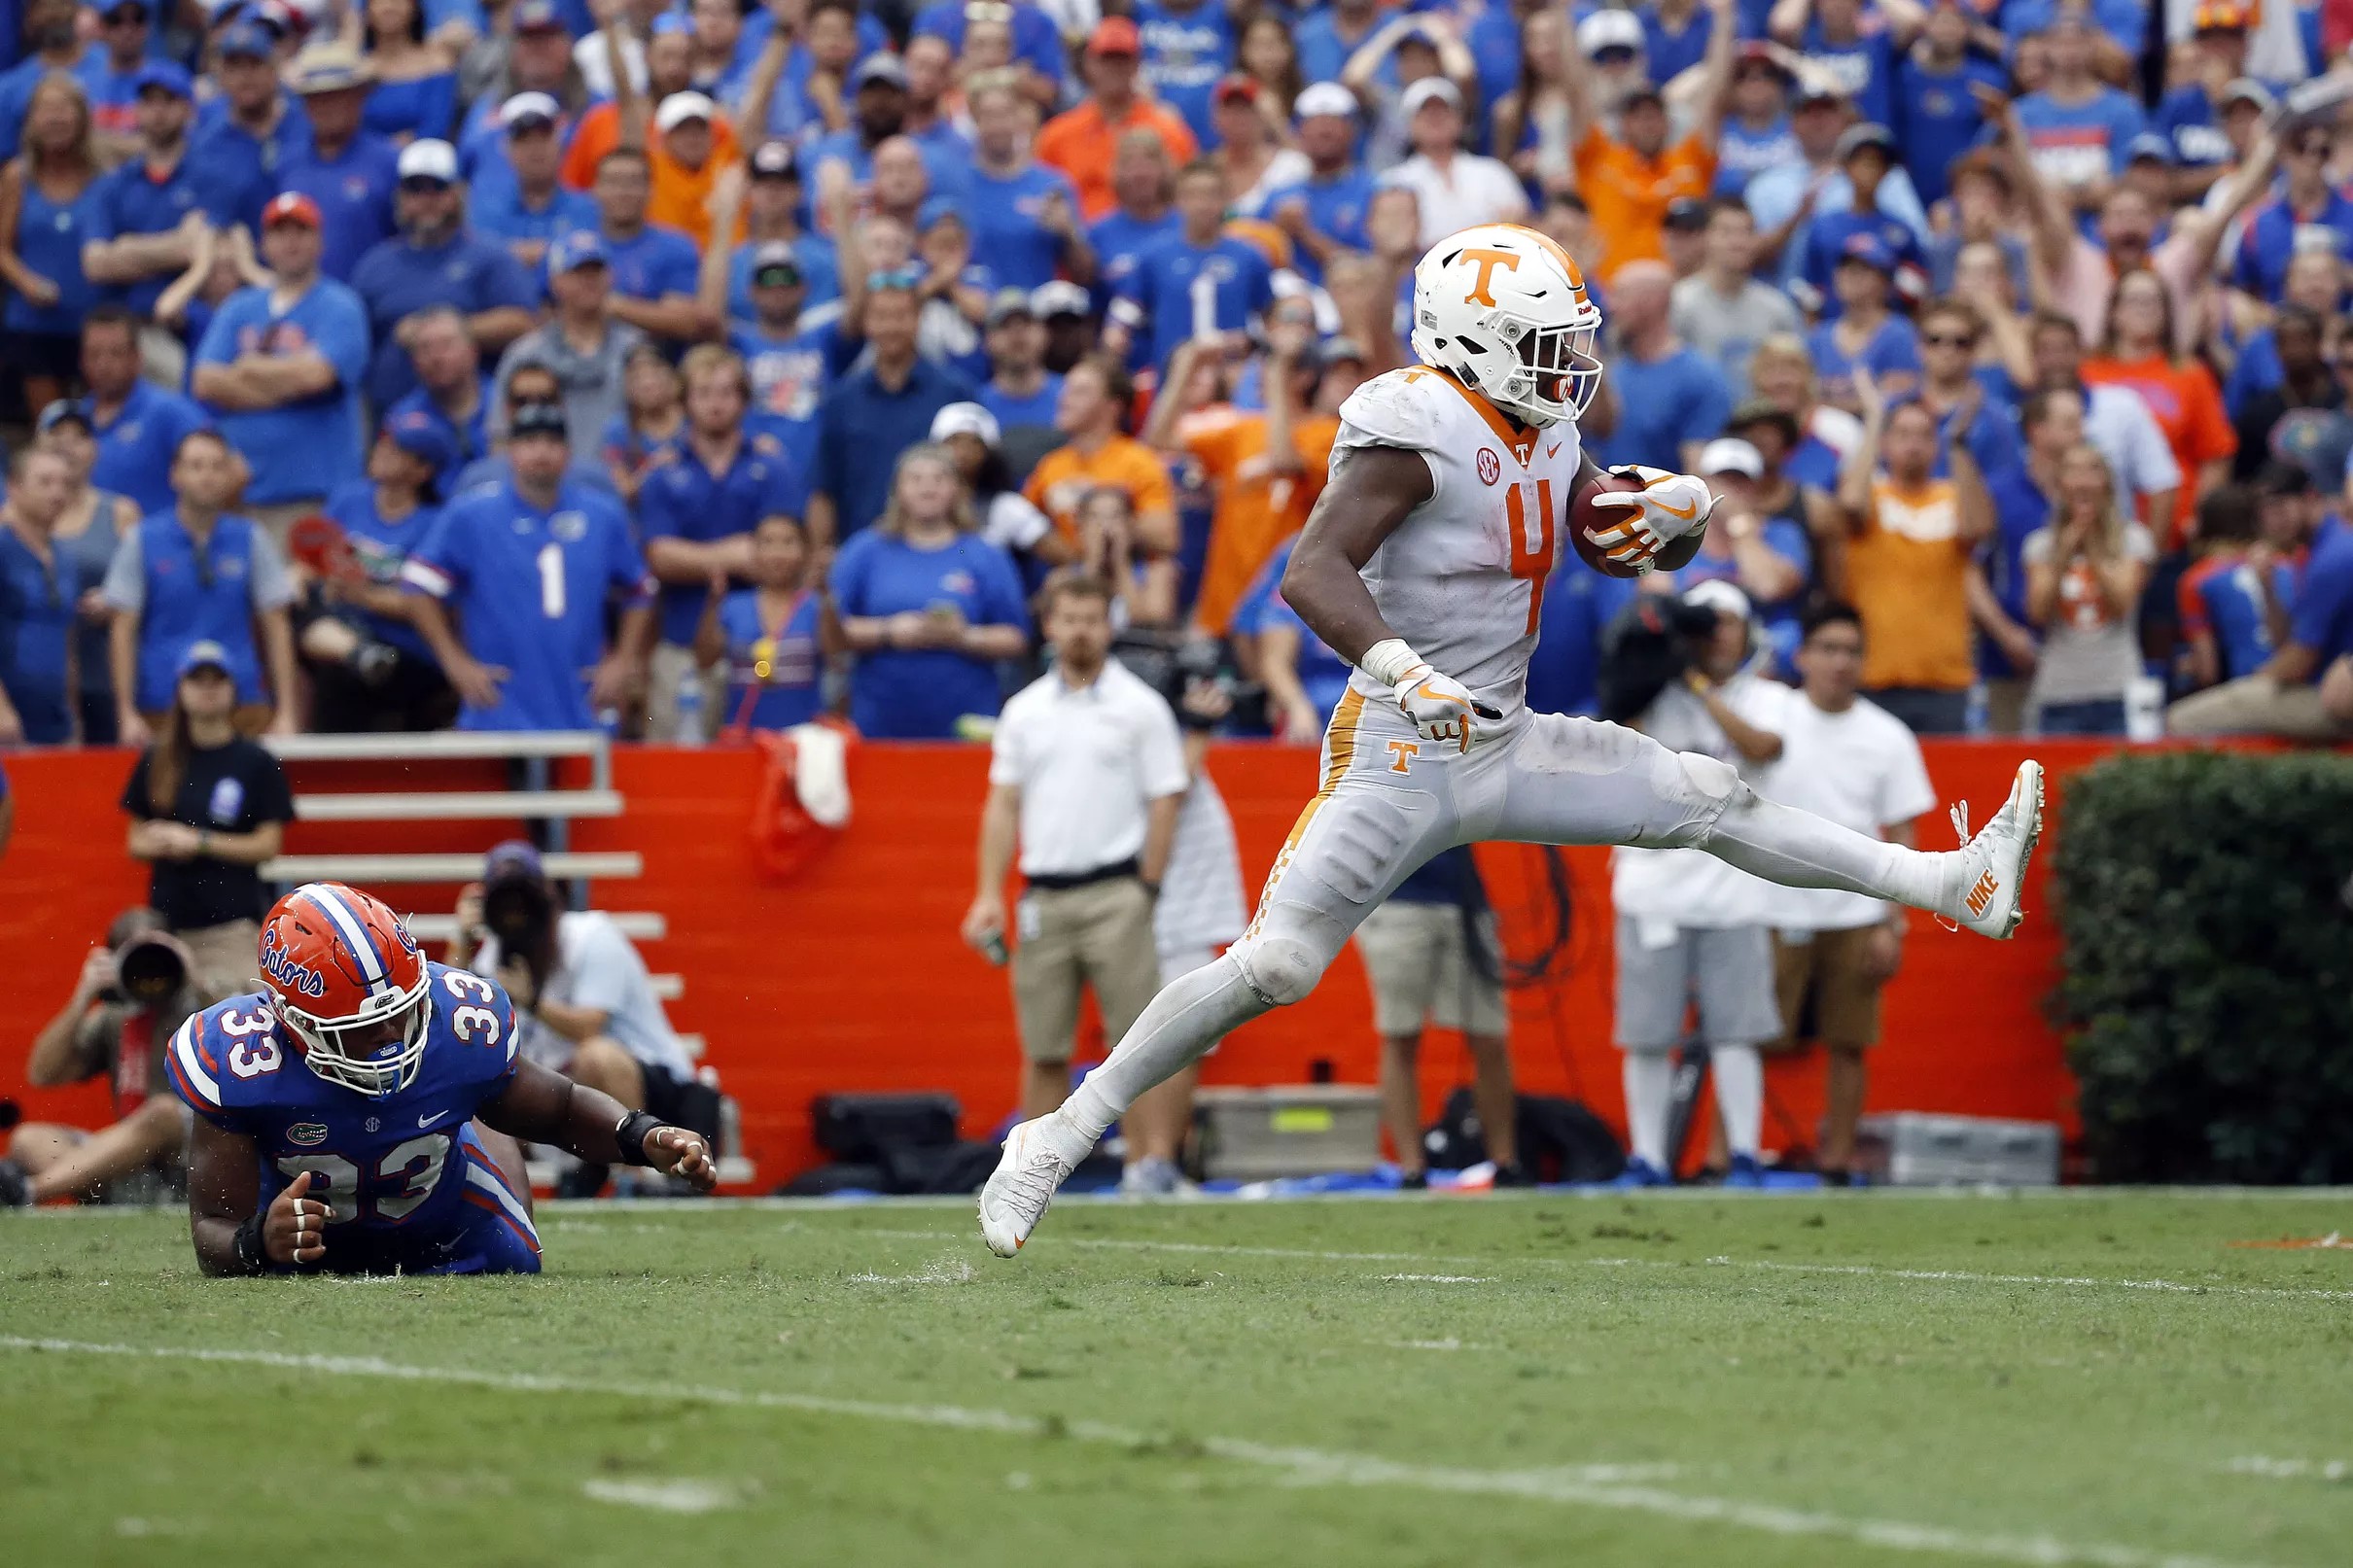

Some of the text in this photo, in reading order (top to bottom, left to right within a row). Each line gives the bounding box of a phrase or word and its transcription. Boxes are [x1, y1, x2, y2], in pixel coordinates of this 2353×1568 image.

[1459, 249, 1521, 307] T
[1477, 449, 1499, 484] SEC
[1515, 443, 1528, 466] T
[536, 542, 565, 618] 1
[1505, 479, 1555, 636] 4
[1387, 740, 1419, 774] T
[1965, 867, 1999, 918] NIKE
[261, 928, 324, 997] Gators
[441, 970, 501, 1047] 33
[220, 1006, 283, 1078] 33
[365, 1116, 381, 1132] SEC
[277, 1132, 450, 1224] 33
